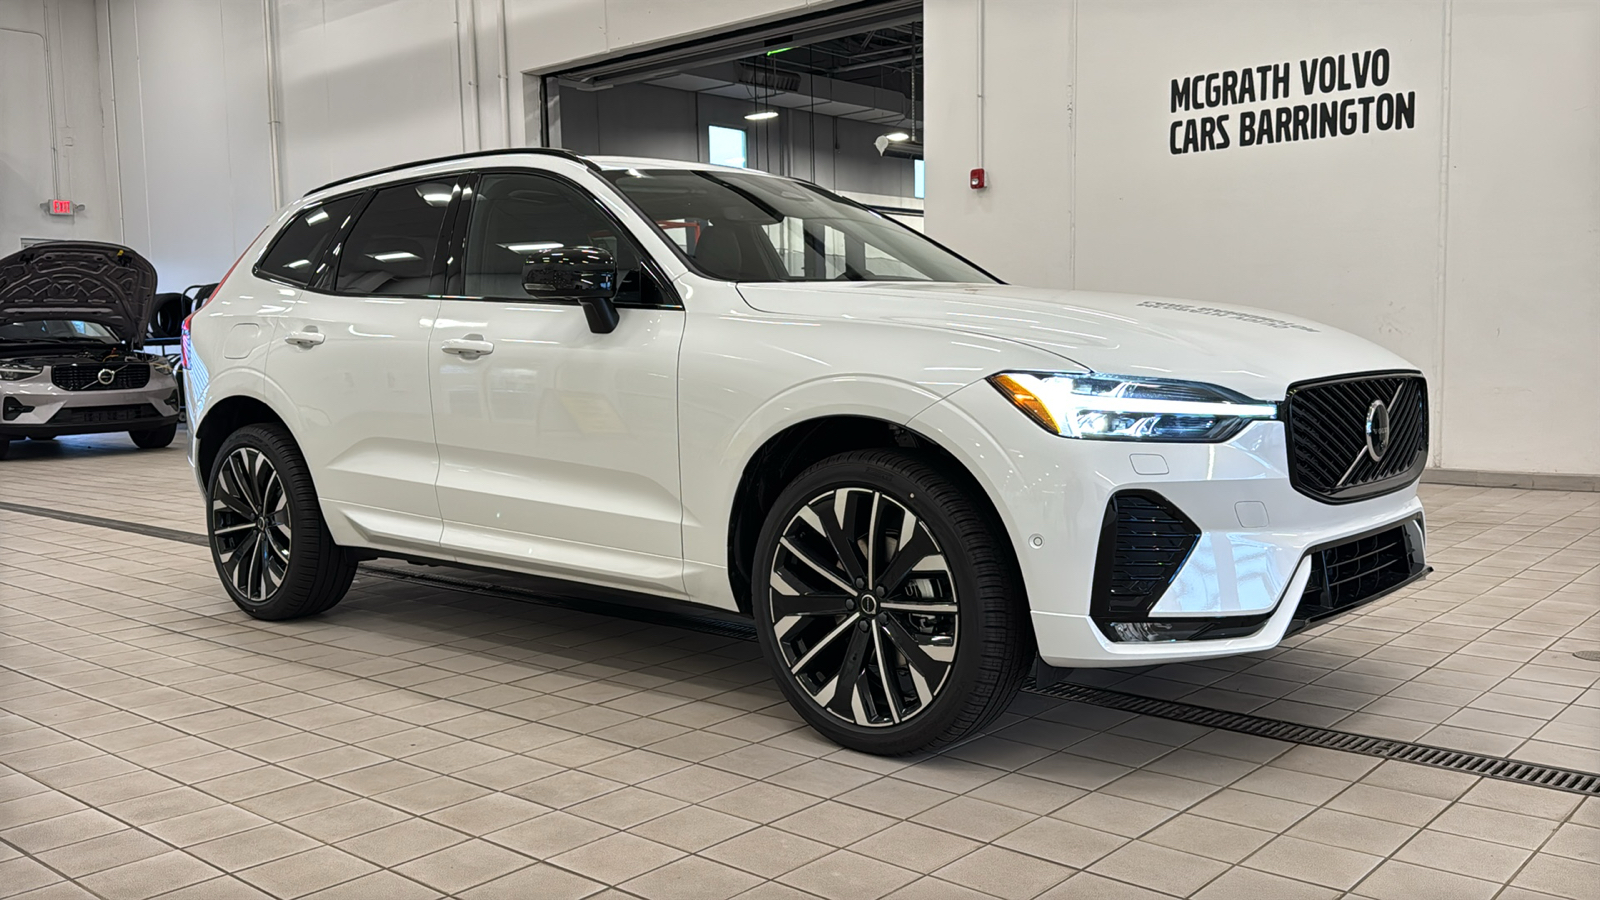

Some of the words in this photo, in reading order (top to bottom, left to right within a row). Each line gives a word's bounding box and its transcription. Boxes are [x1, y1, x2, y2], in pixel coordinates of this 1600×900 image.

[1170, 62, 1291, 114] MCGRATH
[1299, 48, 1390, 96] VOLVO
[1169, 114, 1231, 155] CARS
[1239, 91, 1416, 147] BARRINGTON
[52, 199, 71, 213] EXIT
